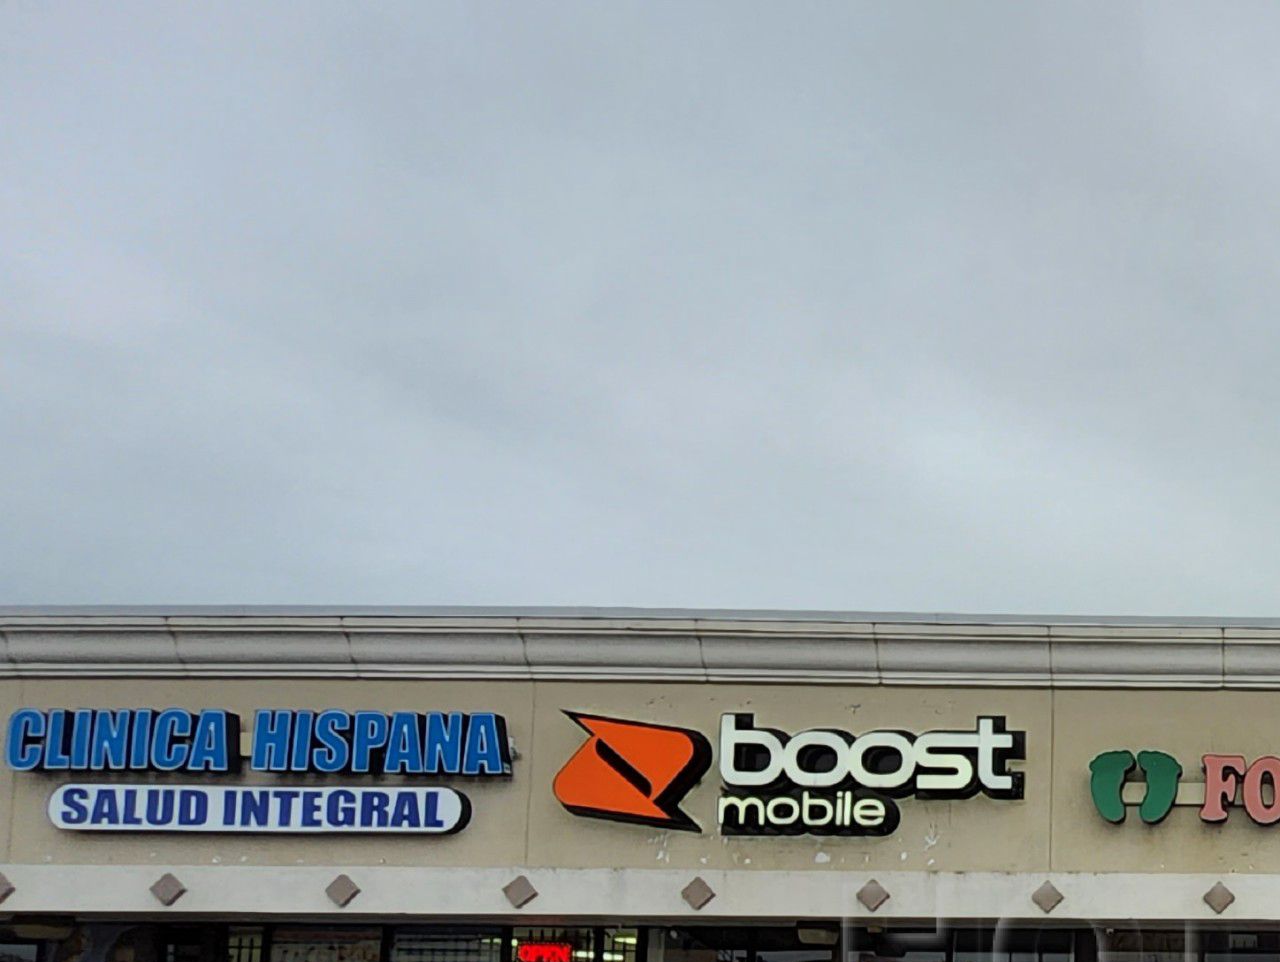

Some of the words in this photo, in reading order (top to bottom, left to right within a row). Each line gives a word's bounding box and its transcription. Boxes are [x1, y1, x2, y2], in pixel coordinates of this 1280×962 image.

[5, 707, 230, 772] CLINICA
[251, 709, 509, 774] HISPANA
[719, 713, 1013, 790] boost
[61, 787, 209, 826] SALUD
[222, 789, 445, 828] INTEGRAL
[718, 791, 887, 827] mobile
